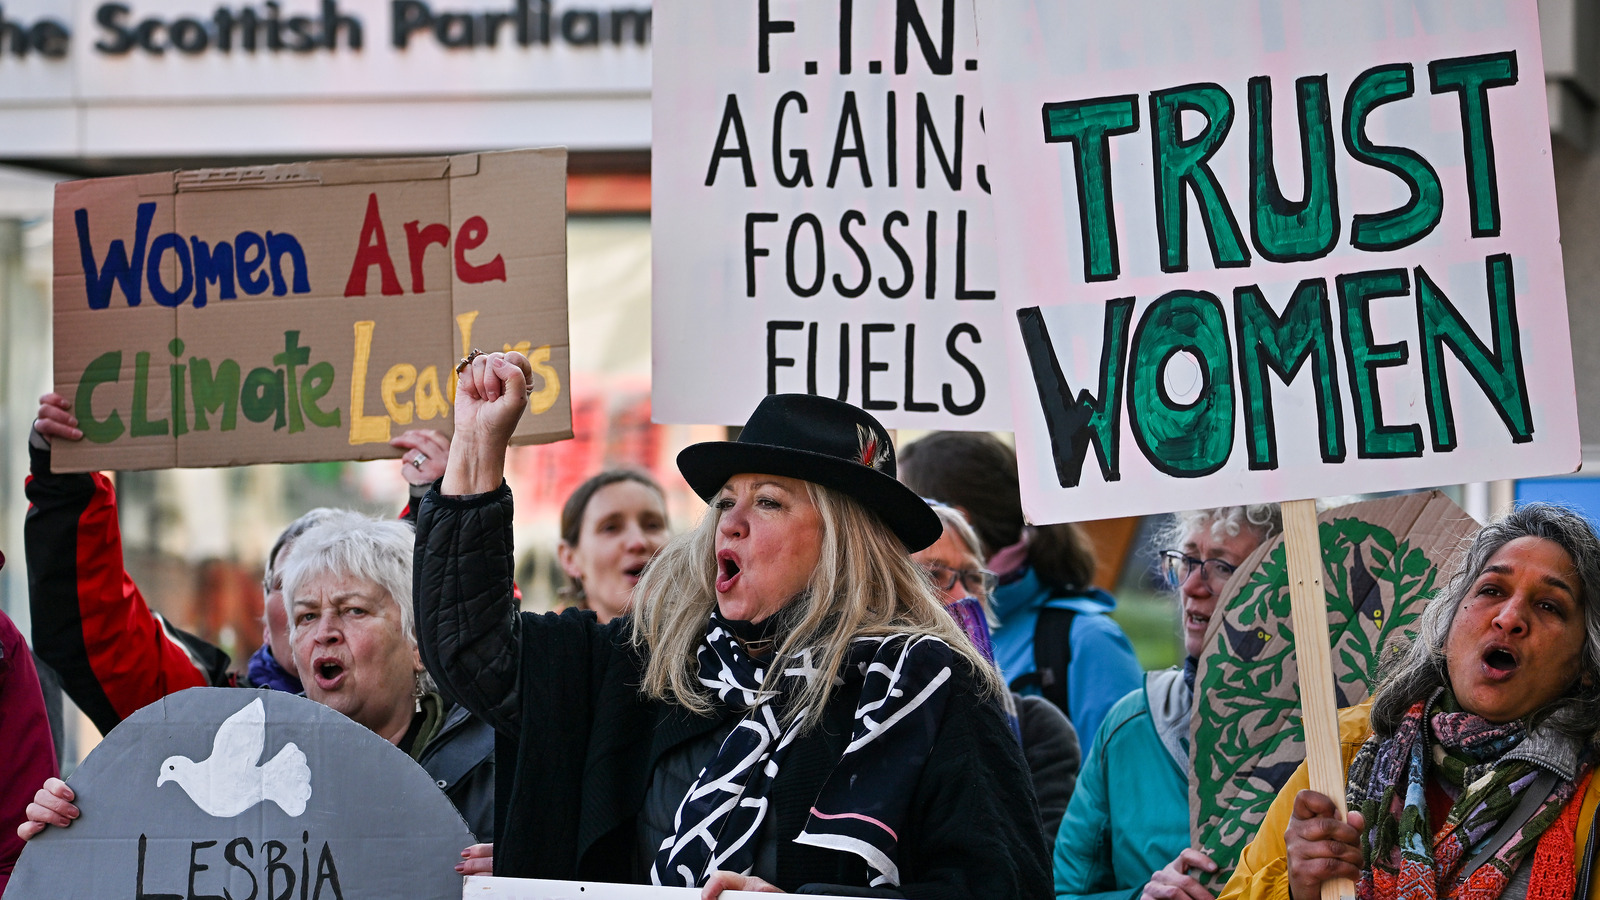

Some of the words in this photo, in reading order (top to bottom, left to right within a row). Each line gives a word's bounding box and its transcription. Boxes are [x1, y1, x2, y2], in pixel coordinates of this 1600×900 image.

[94, 1, 364, 54] Scottish
[758, 0, 978, 75] F.I.N.
[1041, 50, 1518, 283] TRUST
[74, 202, 311, 310] Women
[344, 193, 507, 297] Are
[745, 209, 996, 300] FOSSIL
[766, 320, 986, 416] FUELS
[1016, 252, 1534, 488] WOMEN
